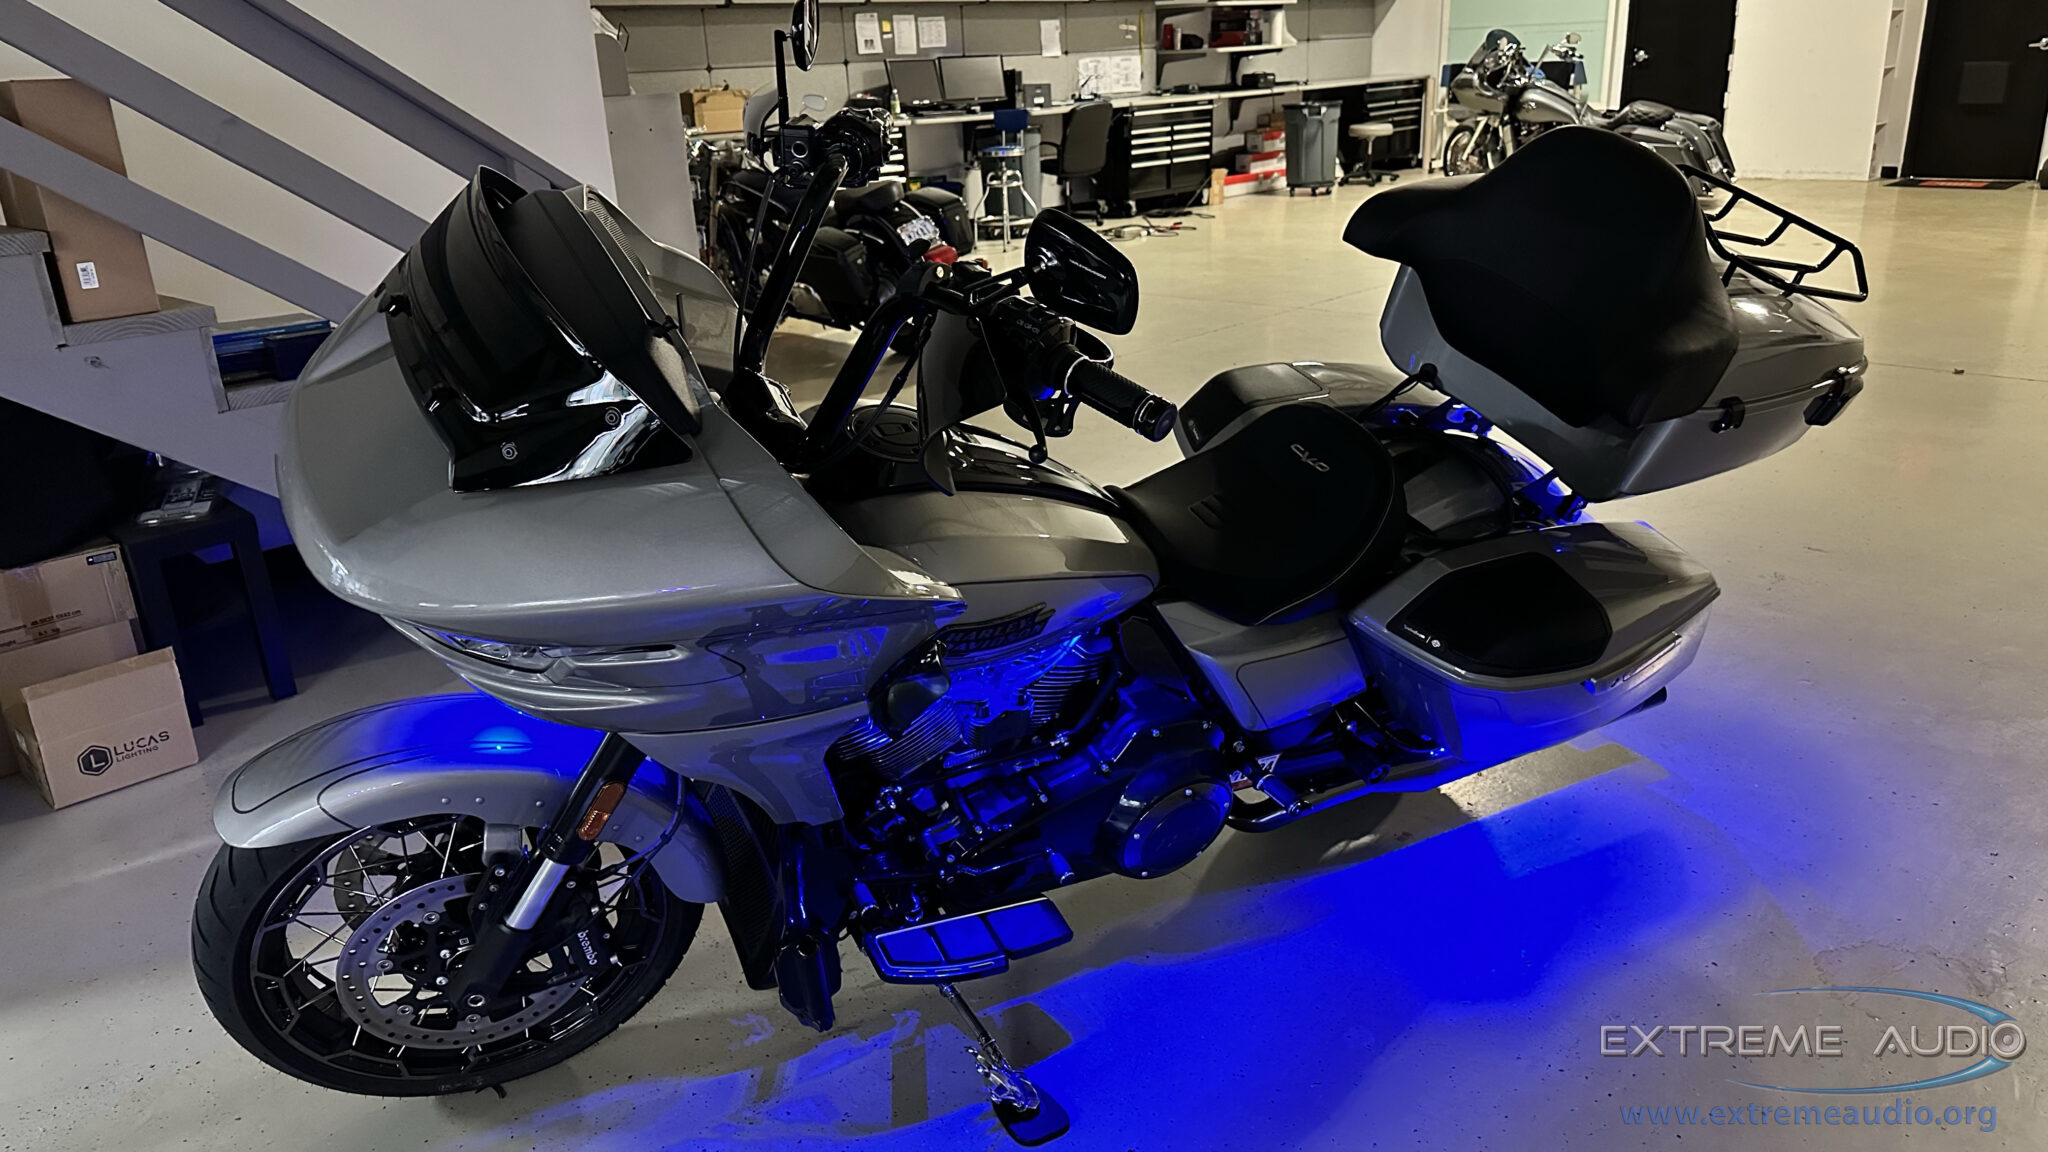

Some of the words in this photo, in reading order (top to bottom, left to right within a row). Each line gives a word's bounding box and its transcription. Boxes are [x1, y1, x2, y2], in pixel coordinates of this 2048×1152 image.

[113, 731, 170, 756] LUCAS
[116, 745, 159, 763] LIGHTING
[577, 930, 598, 966] brembo
